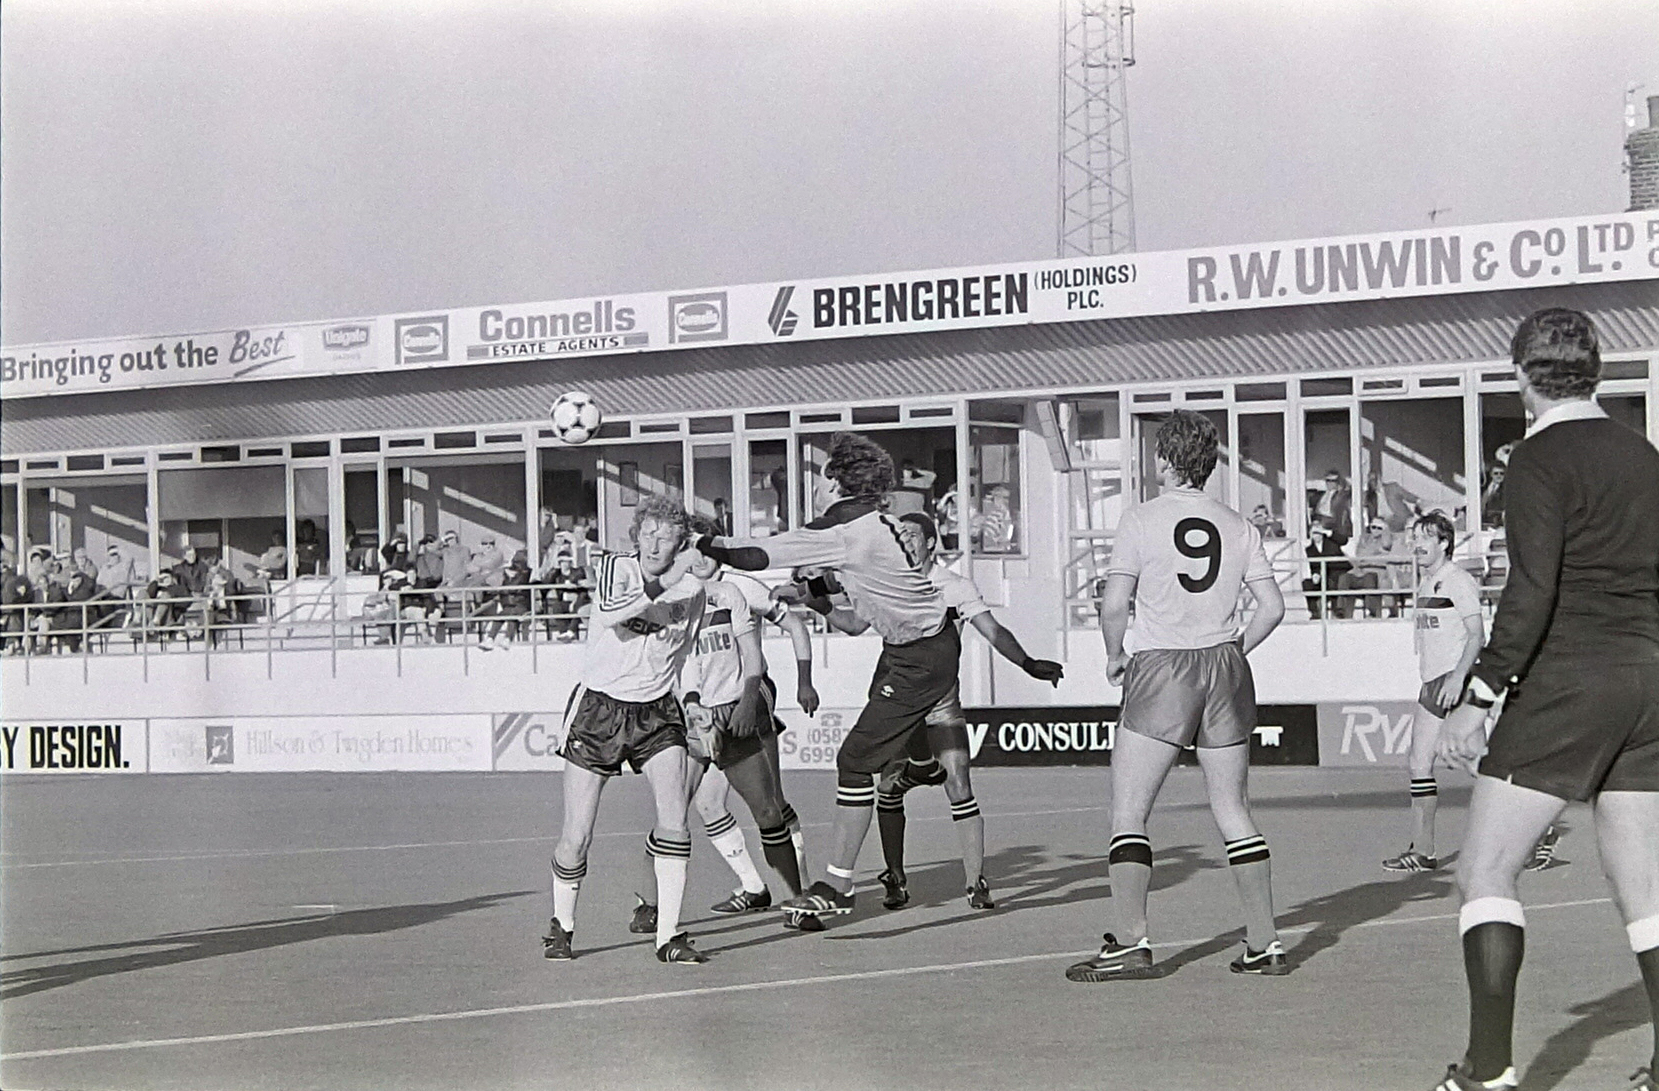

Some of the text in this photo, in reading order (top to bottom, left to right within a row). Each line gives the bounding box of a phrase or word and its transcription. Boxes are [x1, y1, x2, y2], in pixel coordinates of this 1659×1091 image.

[1034, 264, 1137, 290] (HOLDINGS)
[1188, 250, 1288, 303] R.W.
[1295, 236, 1461, 295] UNWIN
[1473, 241, 1498, 281] &
[480, 300, 636, 341] Connells
[813, 273, 1028, 329] BRENGREEN
[1067, 290, 1104, 310] PLC.
[0, 330, 285, 385] Bringing out the Best
[493, 337, 619, 357] ESTATE AGENTS
[1173, 517, 1222, 593] 9
[0, 725, 130, 769] Y DESIGN.
[247, 730, 305, 754] Hillson
[408, 729, 474, 753] Homes
